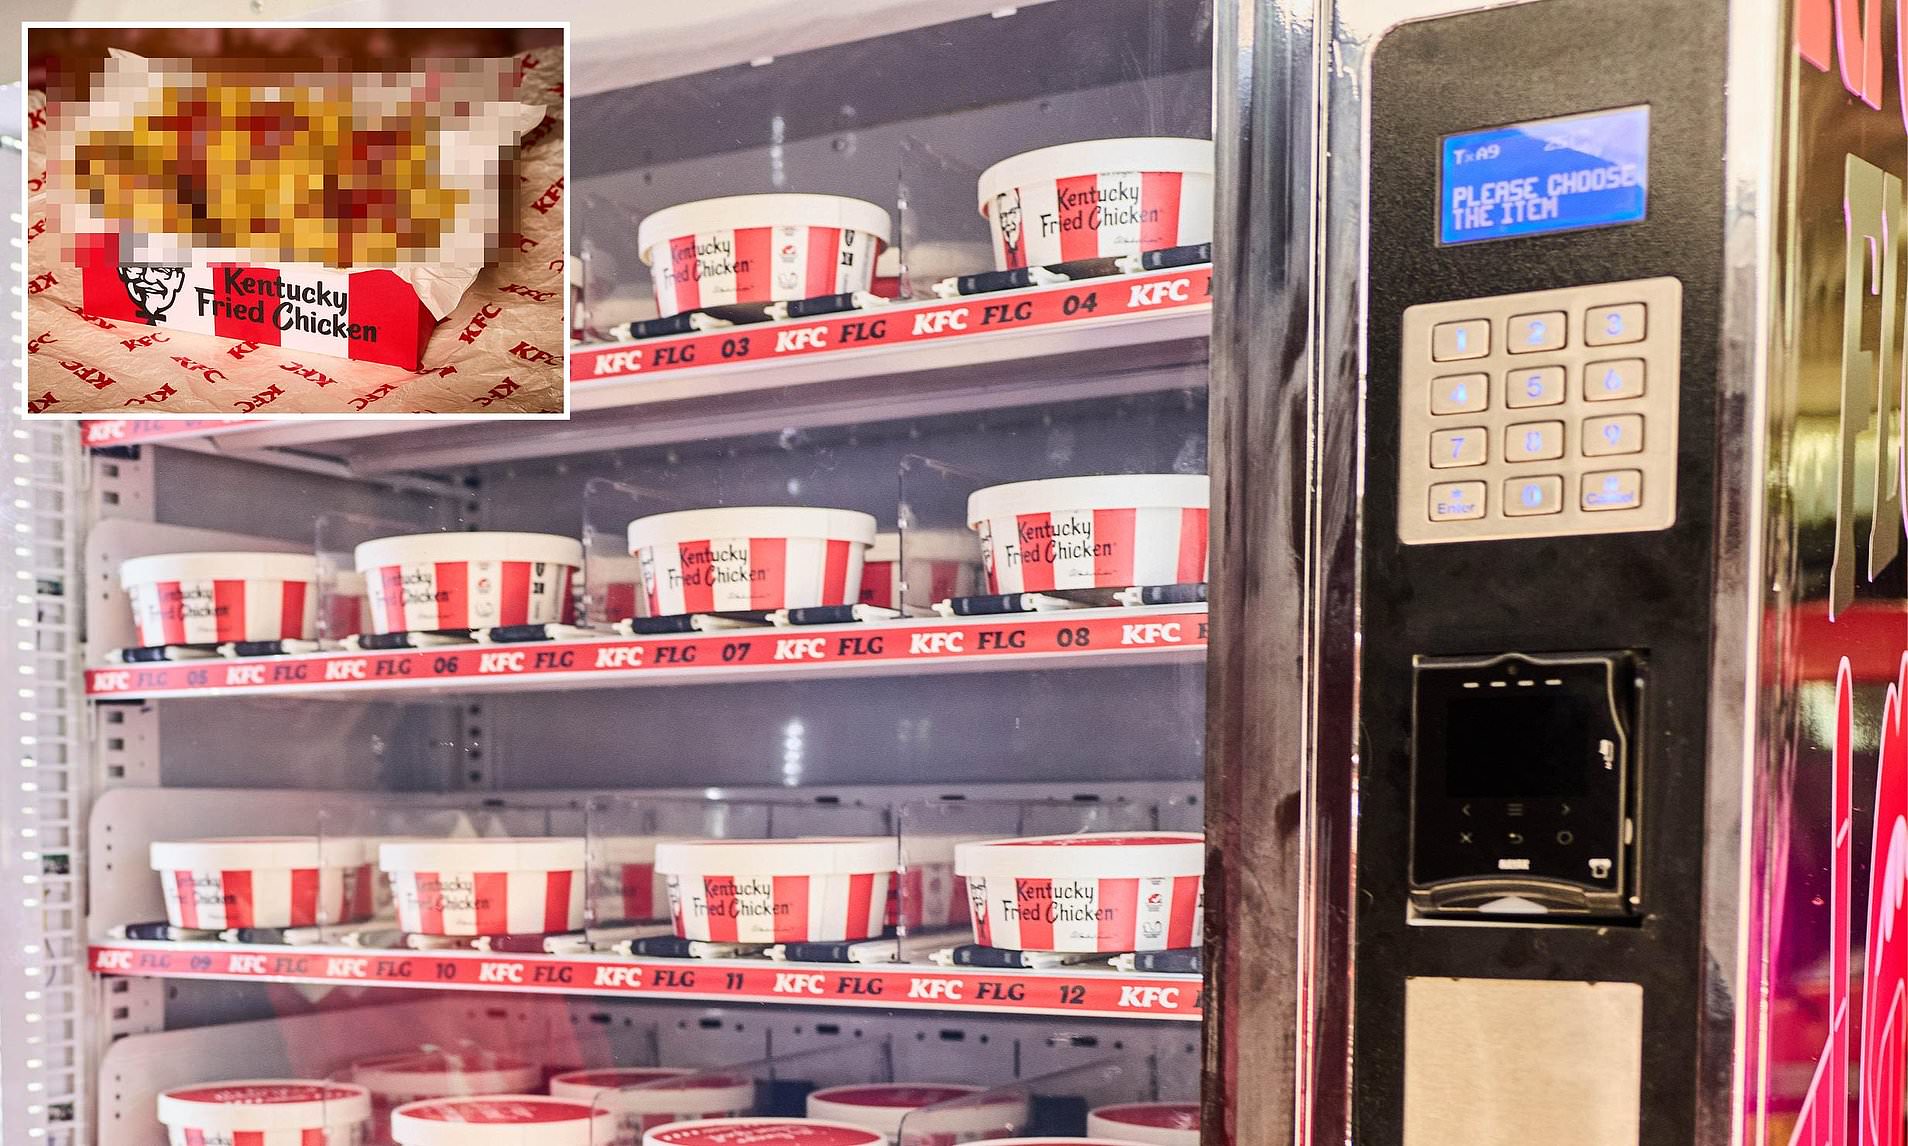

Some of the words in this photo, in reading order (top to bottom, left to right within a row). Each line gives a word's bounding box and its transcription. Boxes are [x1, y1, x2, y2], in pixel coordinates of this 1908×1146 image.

[1056, 181, 1140, 211] Kentucky
[1453, 176, 1540, 208] PLEASE
[1546, 165, 1638, 197] CHOOSE
[1040, 211, 1083, 238] Fried
[1087, 205, 1159, 231] Chicken
[1453, 205, 1495, 231] THE
[1501, 197, 1559, 225] ITEM
[28, 271, 59, 295] KF
[692, 257, 750, 282] Chicken
[223, 266, 349, 317] Kentucky
[195, 286, 266, 324] Fried
[271, 301, 378, 344] Chicken
[459, 302, 502, 345] KFC
[594, 350, 643, 375] KFC
[652, 345, 695, 367] FLG
[721, 337, 750, 358] 03
[775, 326, 828, 352] KFC
[839, 320, 887, 344] FLG
[911, 308, 969, 336] KFC
[981, 301, 1032, 326] FLG
[1062, 292, 1098, 316] 04
[1127, 278, 1190, 308] KFC
[1528, 320, 1547, 345] 2
[1605, 313, 1624, 337] 3
[28, 331, 58, 354] FC
[120, 331, 171, 352] KFC
[227, 340, 261, 360] KF
[58, 359, 116, 390] KFC
[170, 356, 229, 384] KFC
[280, 361, 338, 388] KFC
[233, 383, 286, 414] KFC
[348, 383, 398, 411] KFC
[471, 376, 521, 408] KFC
[1450, 382, 1468, 405] 4
[1526, 375, 1543, 398] 5
[1604, 369, 1622, 391] 6
[1450, 437, 1465, 459] 7
[1525, 430, 1542, 453] 8
[1603, 423, 1621, 446] 9
[1437, 502, 1476, 515] Enter
[1017, 516, 1092, 543] Kentucky
[679, 544, 748, 568] Kentucky
[1005, 543, 1041, 568] Fried
[1045, 540, 1112, 564] Chicken
[668, 568, 701, 589] Fried
[704, 564, 766, 587] Chicken
[94, 671, 130, 691] KFC
[137, 670, 168, 688] FLG
[226, 665, 266, 685] KFC
[273, 664, 307, 681] FLG
[325, 659, 368, 681] KFC
[375, 658, 412, 676] FLG
[433, 656, 458, 674] 06
[479, 651, 525, 674] KFC
[534, 651, 575, 669] FLG
[595, 647, 644, 668] KFC
[653, 645, 697, 664] FLG
[721, 643, 752, 662] 07
[774, 638, 825, 661] KFC
[837, 637, 884, 656] FLG
[909, 631, 964, 655] KFC
[977, 630, 1026, 650] FLG
[1056, 627, 1090, 648] 08
[1121, 622, 1181, 646] KFC
[703, 879, 771, 898] Kentucky
[1016, 880, 1094, 904] Kentucky
[693, 897, 725, 918] Fried
[728, 898, 789, 919] Chicken
[1002, 900, 1041, 922] Fried
[1045, 902, 1114, 924] Chicken
[97, 951, 133, 969] KFC
[139, 951, 171, 968] FLG
[227, 954, 267, 974] KFC
[274, 957, 308, 974] FLG
[327, 958, 367, 978] KFC
[376, 960, 412, 977] FLG
[436, 963, 457, 979] 10
[479, 962, 524, 983] KFC
[533, 966, 573, 983] FLG
[594, 966, 642, 987] KFC
[653, 970, 695, 988] FLG
[726, 972, 744, 990] 11
[773, 973, 826, 995] KFC
[837, 977, 884, 995] FLG
[907, 978, 964, 1000] KFC
[975, 982, 1025, 1001] FLG
[1060, 985, 1087, 1005] 12
[1118, 986, 1179, 1009] KFC
